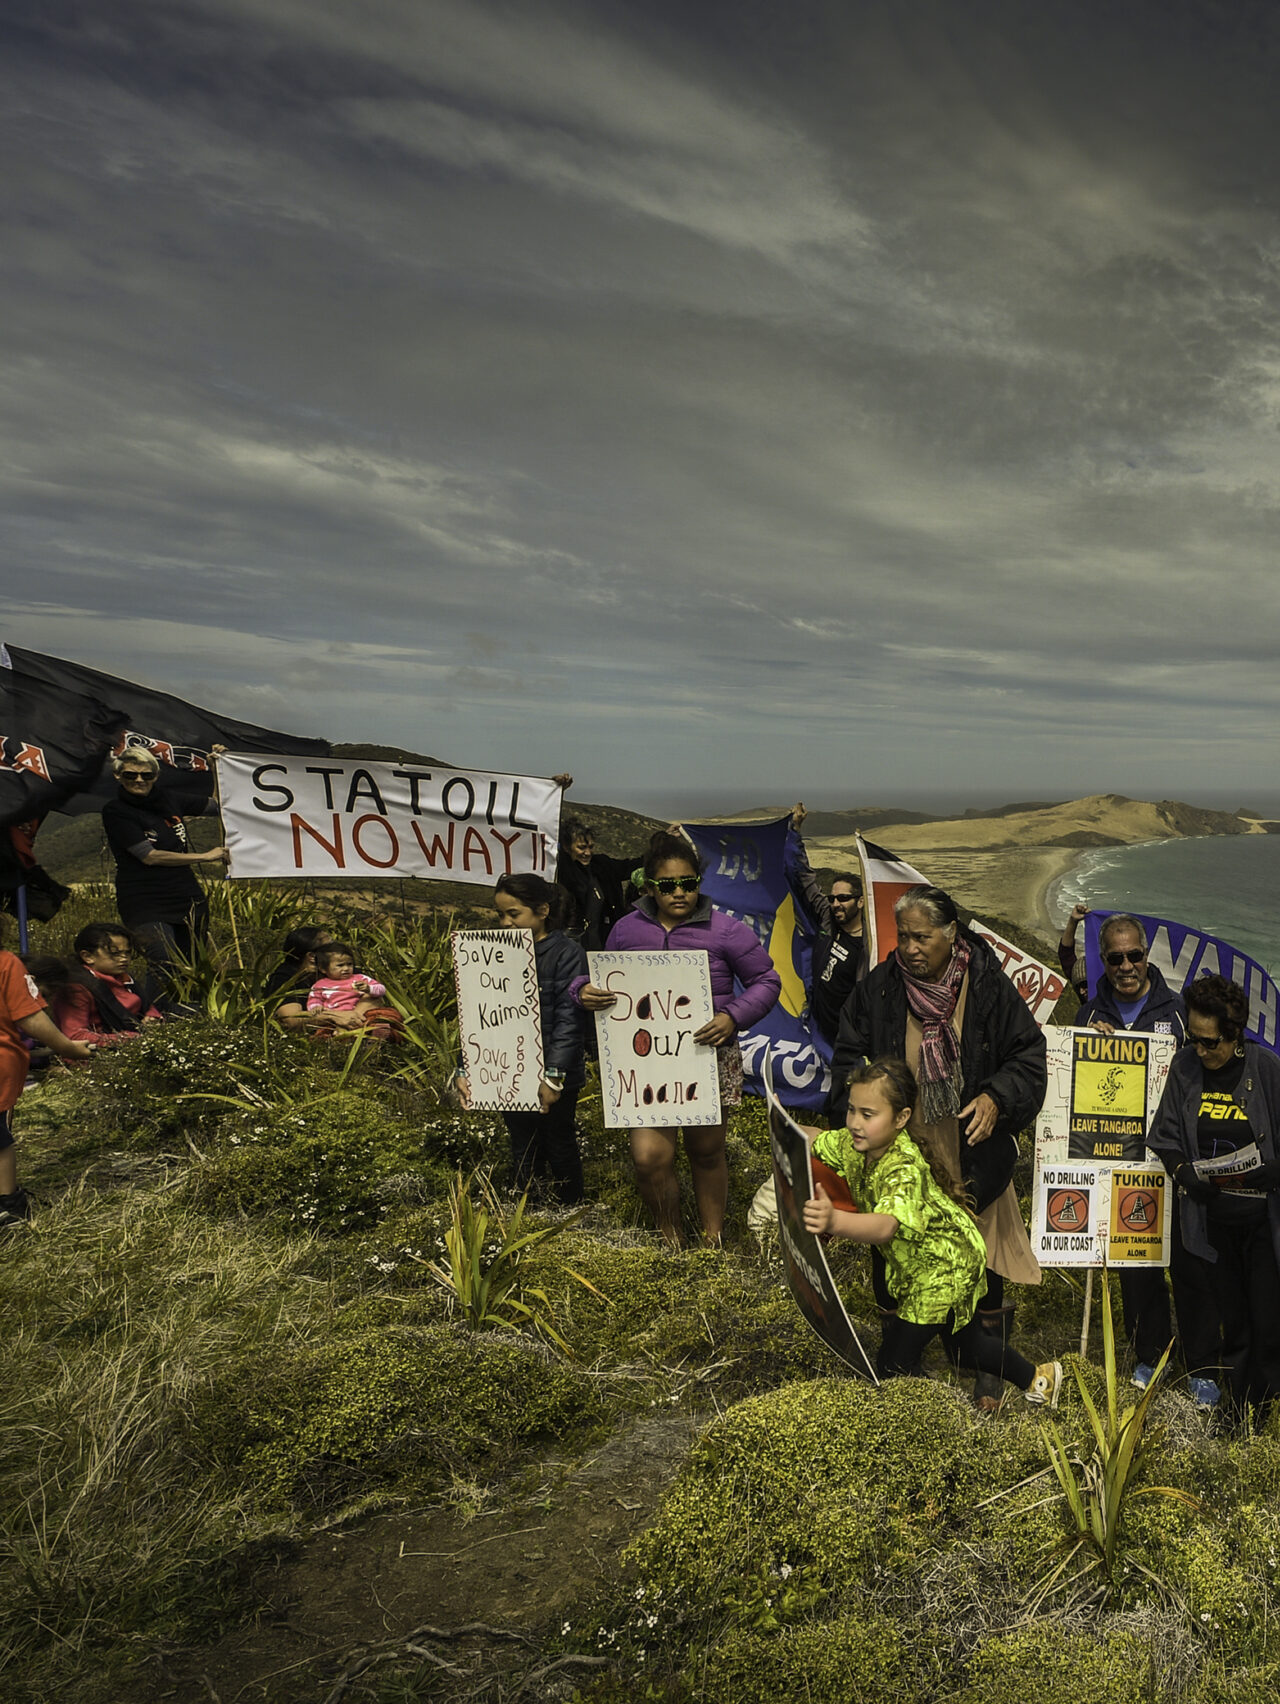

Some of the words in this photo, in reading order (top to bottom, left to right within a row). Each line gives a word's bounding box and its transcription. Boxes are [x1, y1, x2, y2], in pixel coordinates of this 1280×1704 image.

[252, 764, 538, 831] STATOIL
[290, 813, 399, 869] NO
[459, 943, 505, 966] Save
[606, 970, 691, 1021] Save
[468, 1033, 510, 1069] Save
[632, 1028, 692, 1057] Our
[1075, 1036, 1147, 1063] TUKINO
[616, 1069, 698, 1107] Moana
[1071, 1118, 1098, 1132] LEAVE
[1100, 1120, 1142, 1135] TANGAROA
[1093, 1142, 1123, 1156] ALONE!
[1218, 1157, 1257, 1174] DRILLING
[1043, 1171, 1055, 1184] NO
[1057, 1172, 1095, 1185] DRILLING
[1113, 1173, 1165, 1187] TUKINO
[1041, 1236, 1052, 1251] ON
[1053, 1236, 1069, 1251] OUR
[1070, 1236, 1094, 1251] COAST
[1110, 1236, 1129, 1244] LEAVE
[1127, 1249, 1147, 1257] ALONE
